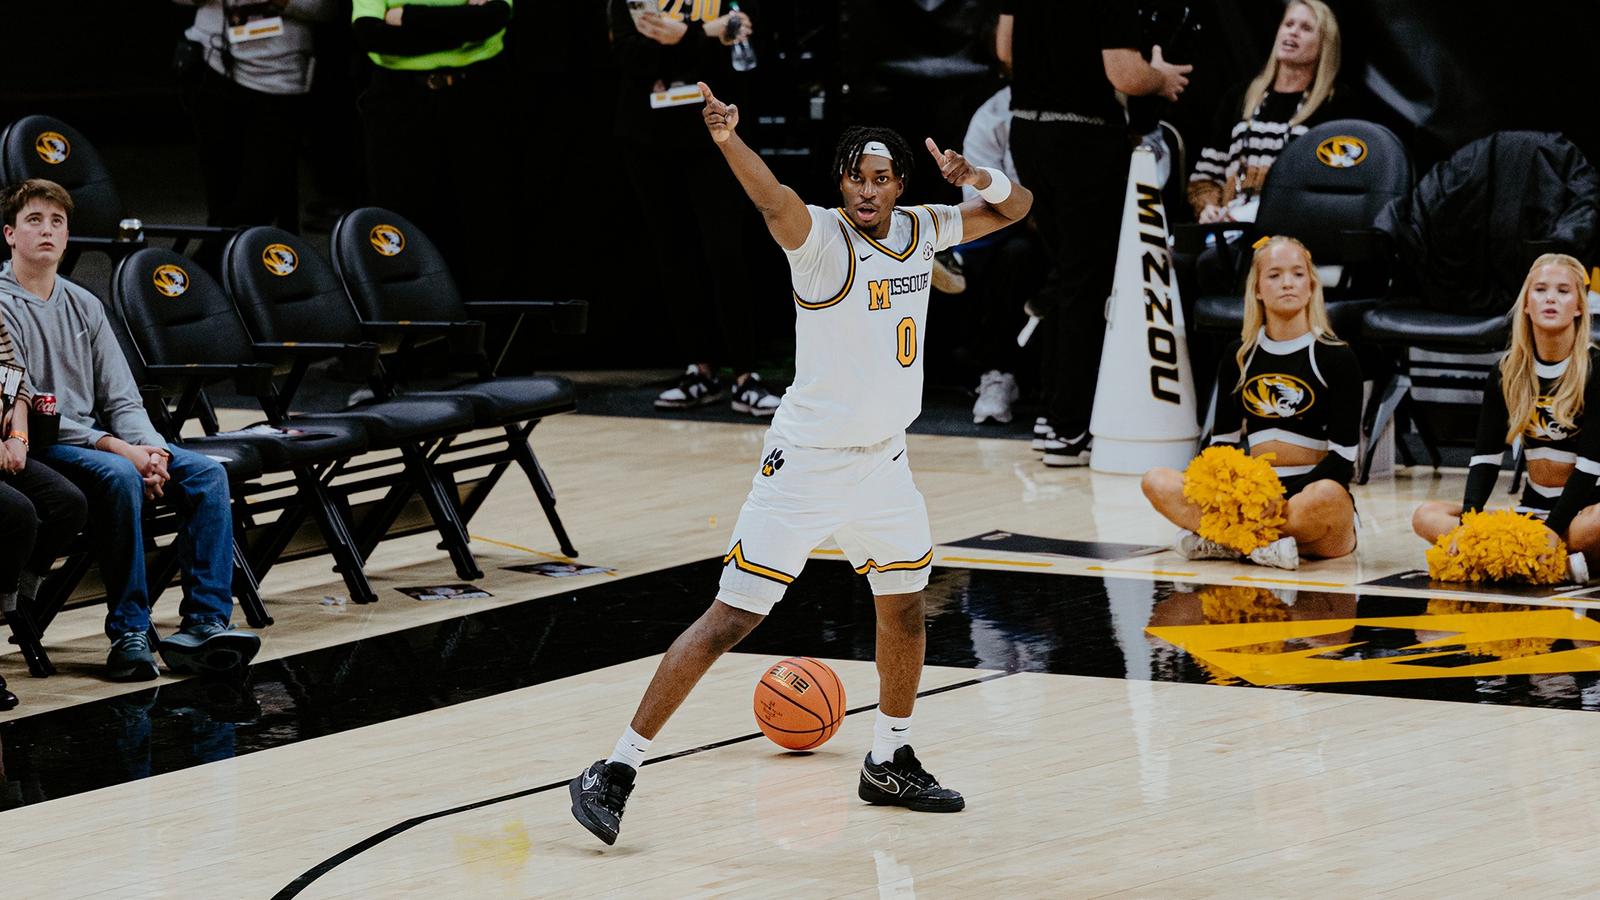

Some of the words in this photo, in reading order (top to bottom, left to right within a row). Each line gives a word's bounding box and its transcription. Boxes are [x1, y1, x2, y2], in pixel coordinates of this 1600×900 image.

[867, 271, 930, 311] MISSOUR
[1135, 182, 1181, 405] MIZZOU
[896, 316, 917, 368] 0
[769, 664, 811, 695] ELITE
